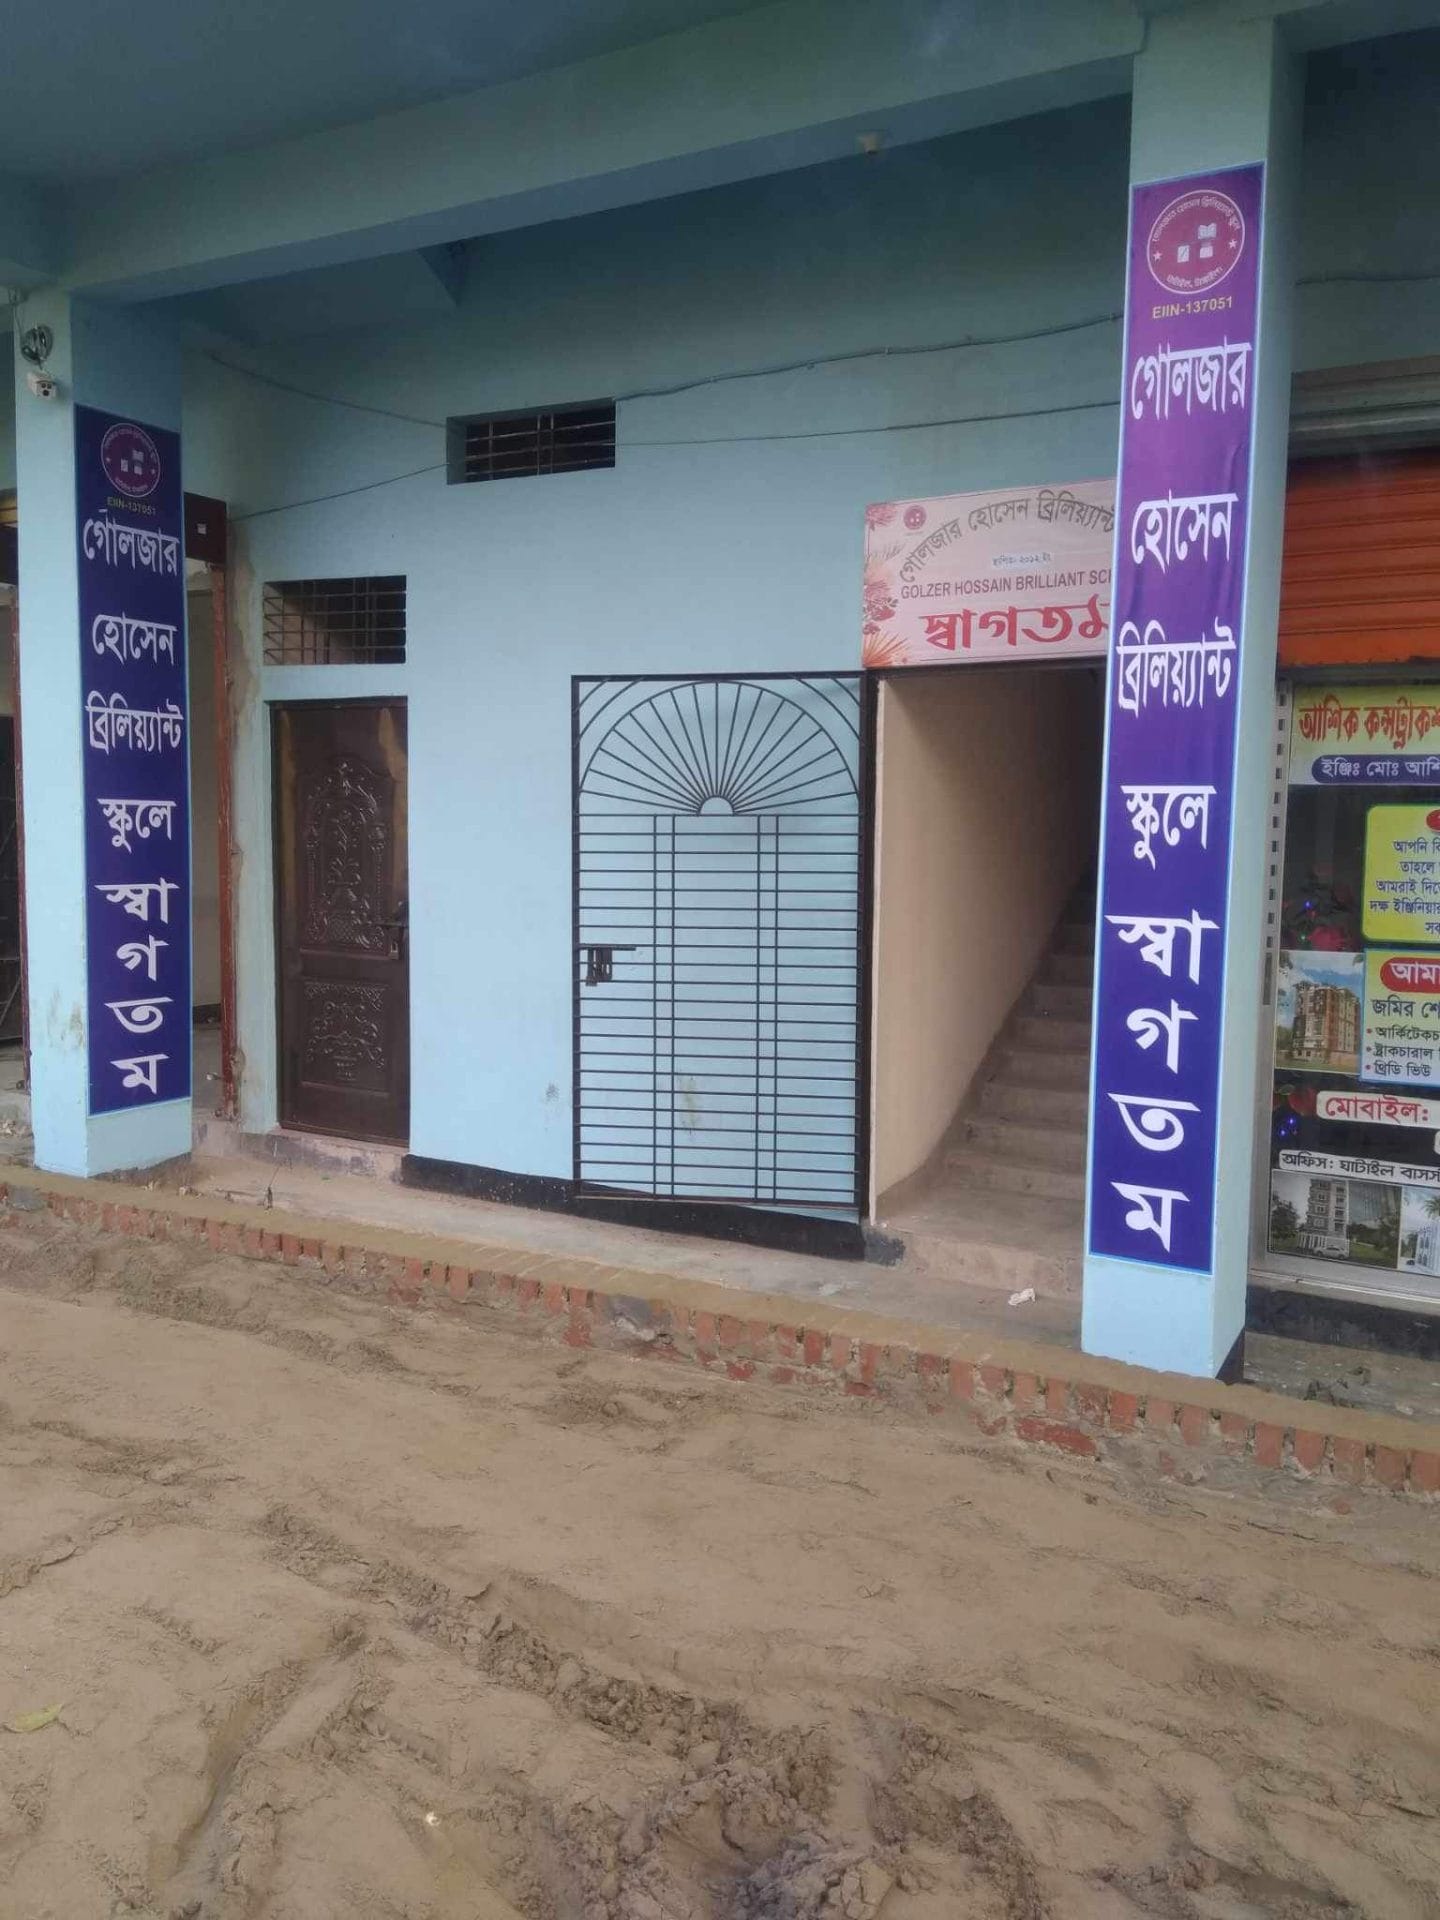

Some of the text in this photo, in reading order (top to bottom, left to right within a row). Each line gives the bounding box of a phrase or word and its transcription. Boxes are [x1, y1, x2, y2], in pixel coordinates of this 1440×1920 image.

[1152, 296, 1232, 319] EIIN-137051
[1131, 335, 1252, 420] গোলজার
[900, 518, 963, 583] গোলজার
[968, 499, 1029, 532] হোসেন
[1131, 489, 1239, 574] হোসেন
[901, 582, 951, 599] GOLZER
[955, 577, 1011, 595] HOSSAIN
[1016, 570, 1084, 589] BRILLIANT
[92, 612, 177, 665] হোসেন
[1299, 693, 1360, 742] আশিক
[1367, 760, 1399, 776] মোঃ
[97, 798, 177, 853] স্কুলে
[1120, 785, 1217, 870] স্কুলে
[1392, 838, 1427, 854] আপনি
[1400, 861, 1434, 875] তাহলে
[1376, 878, 1418, 895] আমরাই
[1372, 995, 1416, 1019] জমির
[1407, 1062, 1432, 1077] ভিউ
[1340, 1160, 1395, 1177] ঘাটাইল
